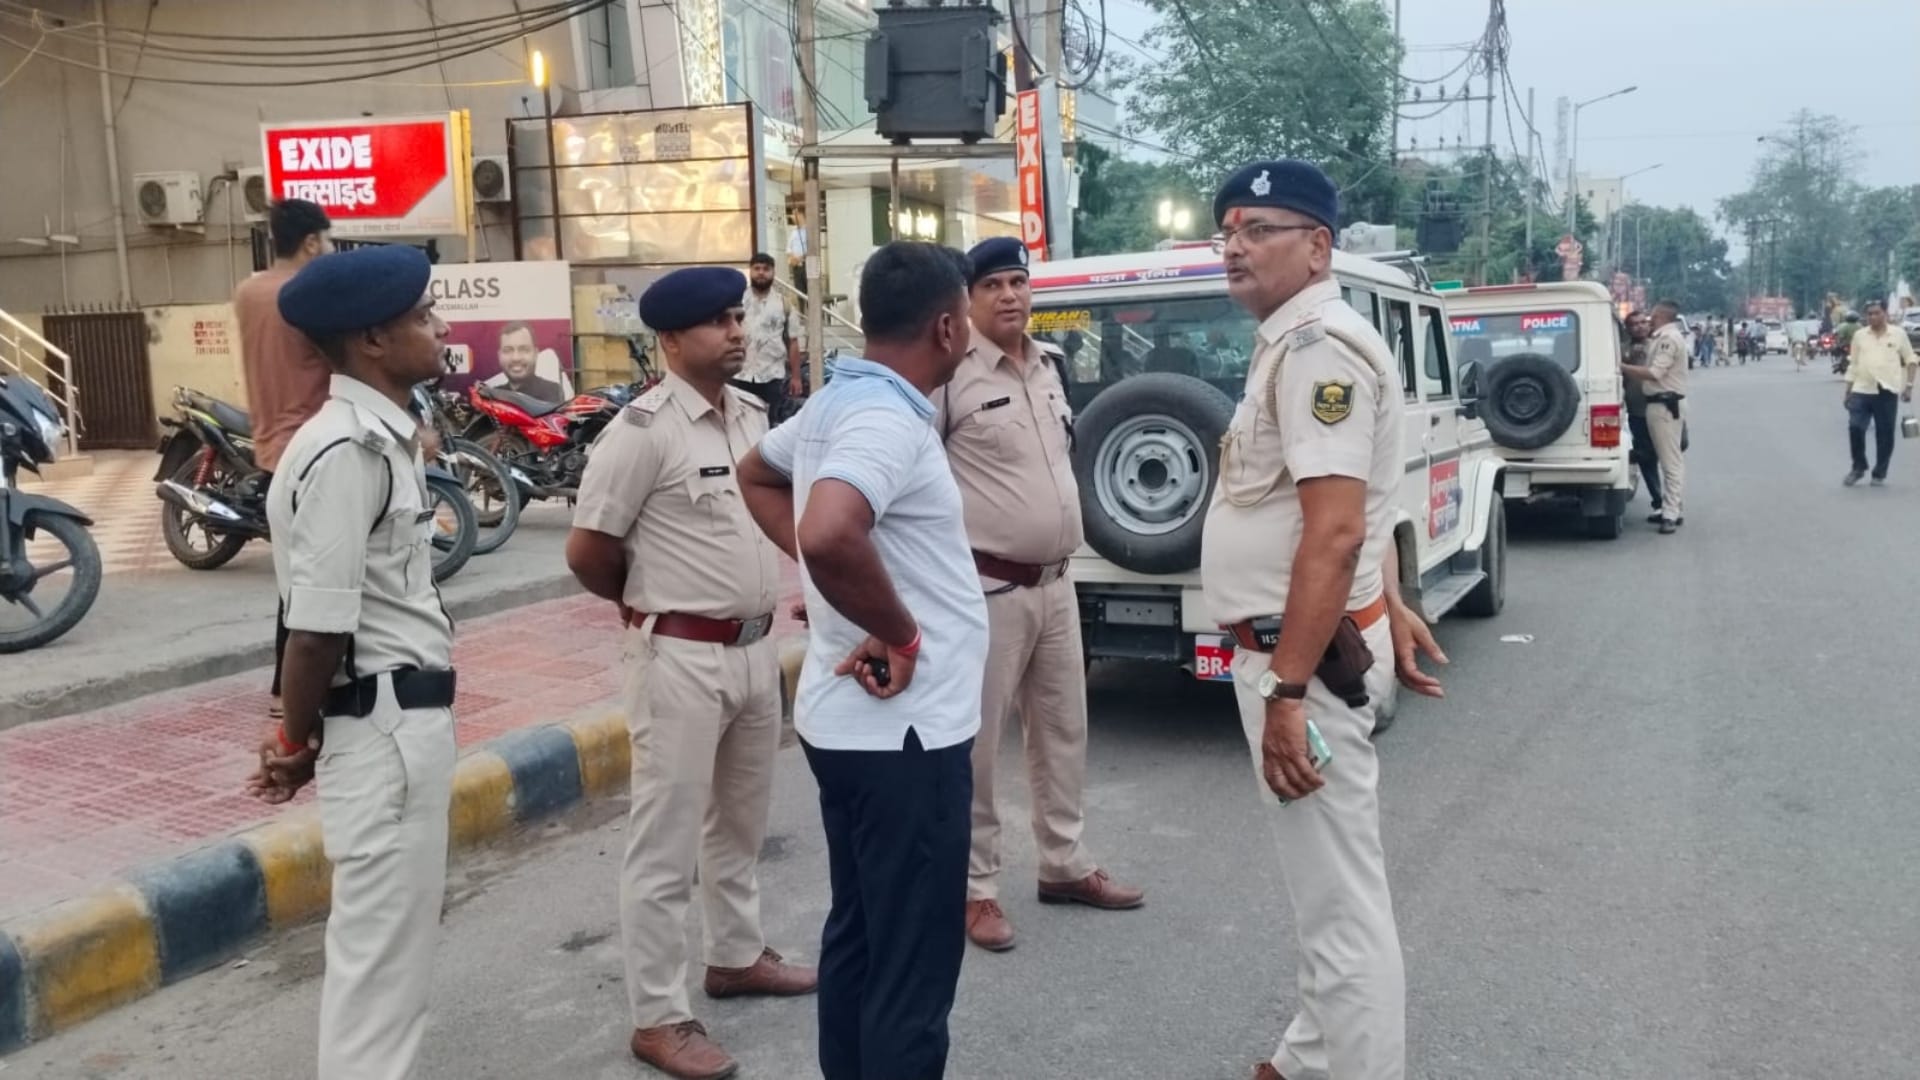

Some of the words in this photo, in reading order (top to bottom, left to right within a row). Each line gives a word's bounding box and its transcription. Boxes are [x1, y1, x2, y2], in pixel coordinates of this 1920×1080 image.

[279, 135, 373, 171] EXIDE
[430, 277, 500, 299] CLASS
[1523, 317, 1568, 329] POLICE
[1196, 655, 1234, 676] BR-
